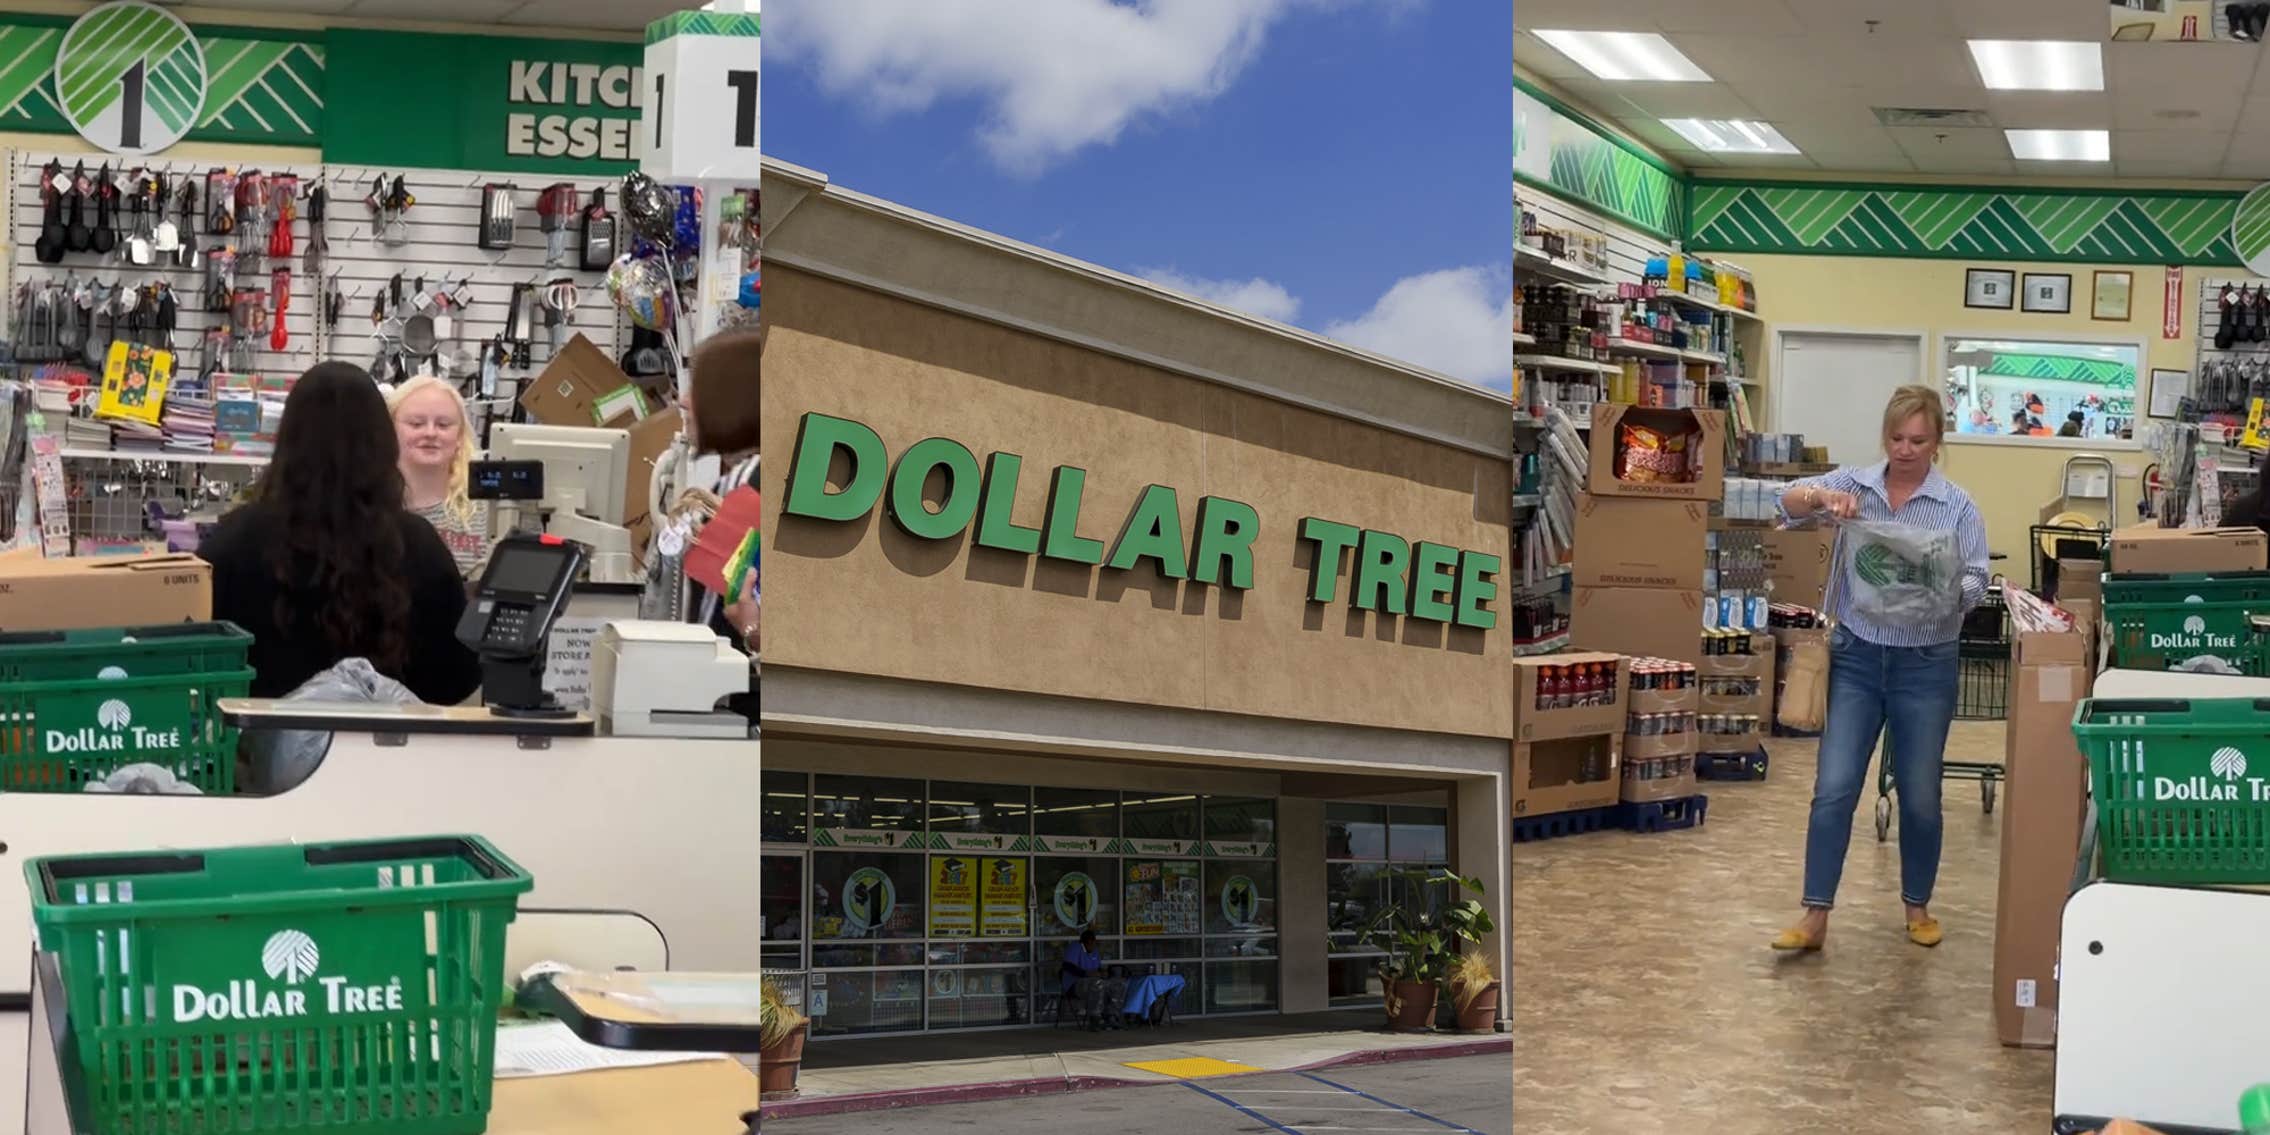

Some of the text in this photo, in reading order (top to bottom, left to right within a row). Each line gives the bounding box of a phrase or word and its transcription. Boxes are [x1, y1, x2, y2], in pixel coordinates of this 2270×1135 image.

[782, 410, 1501, 629] DOLLAR TREE
[171, 573, 200, 585] UNITS
